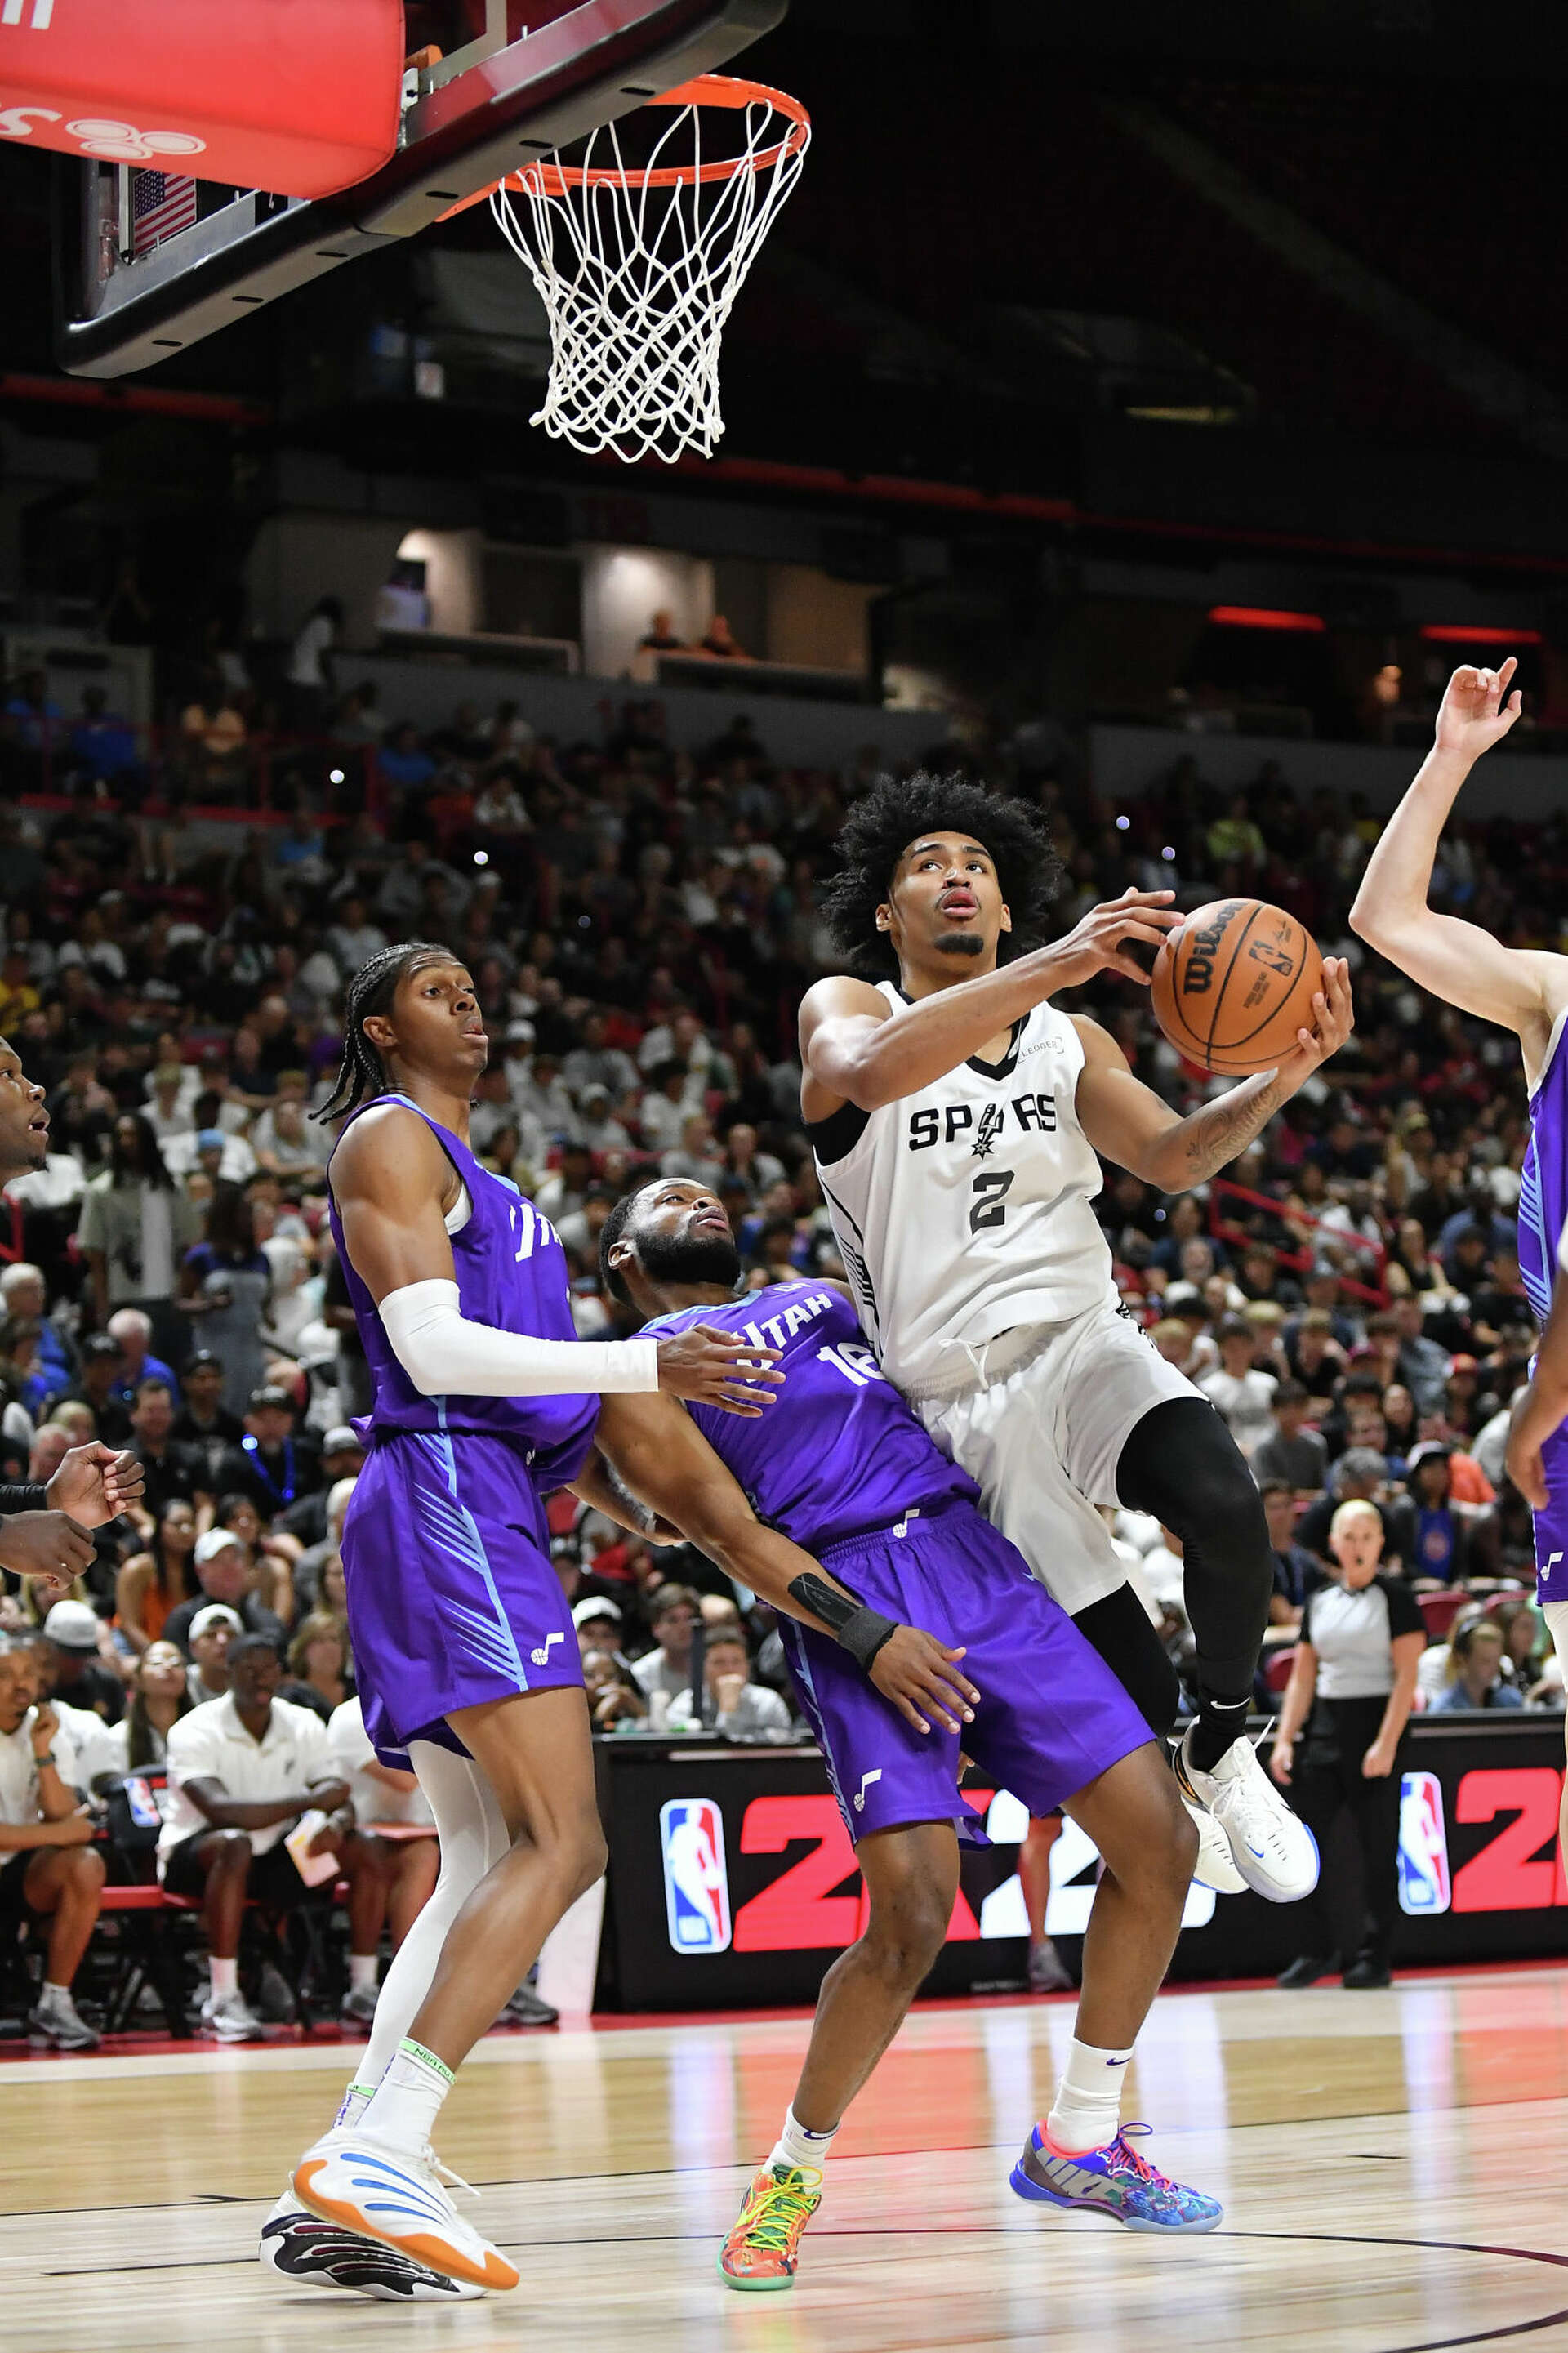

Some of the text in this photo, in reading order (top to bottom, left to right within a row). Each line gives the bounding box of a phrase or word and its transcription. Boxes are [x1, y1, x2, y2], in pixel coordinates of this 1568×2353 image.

[1184, 900, 1250, 995] Wilson
[1021, 1040, 1057, 1058] LEDGER
[969, 1170, 1015, 1236] 2
[817, 1343, 887, 1387] 16
[1451, 1767, 1568, 1913] 2
